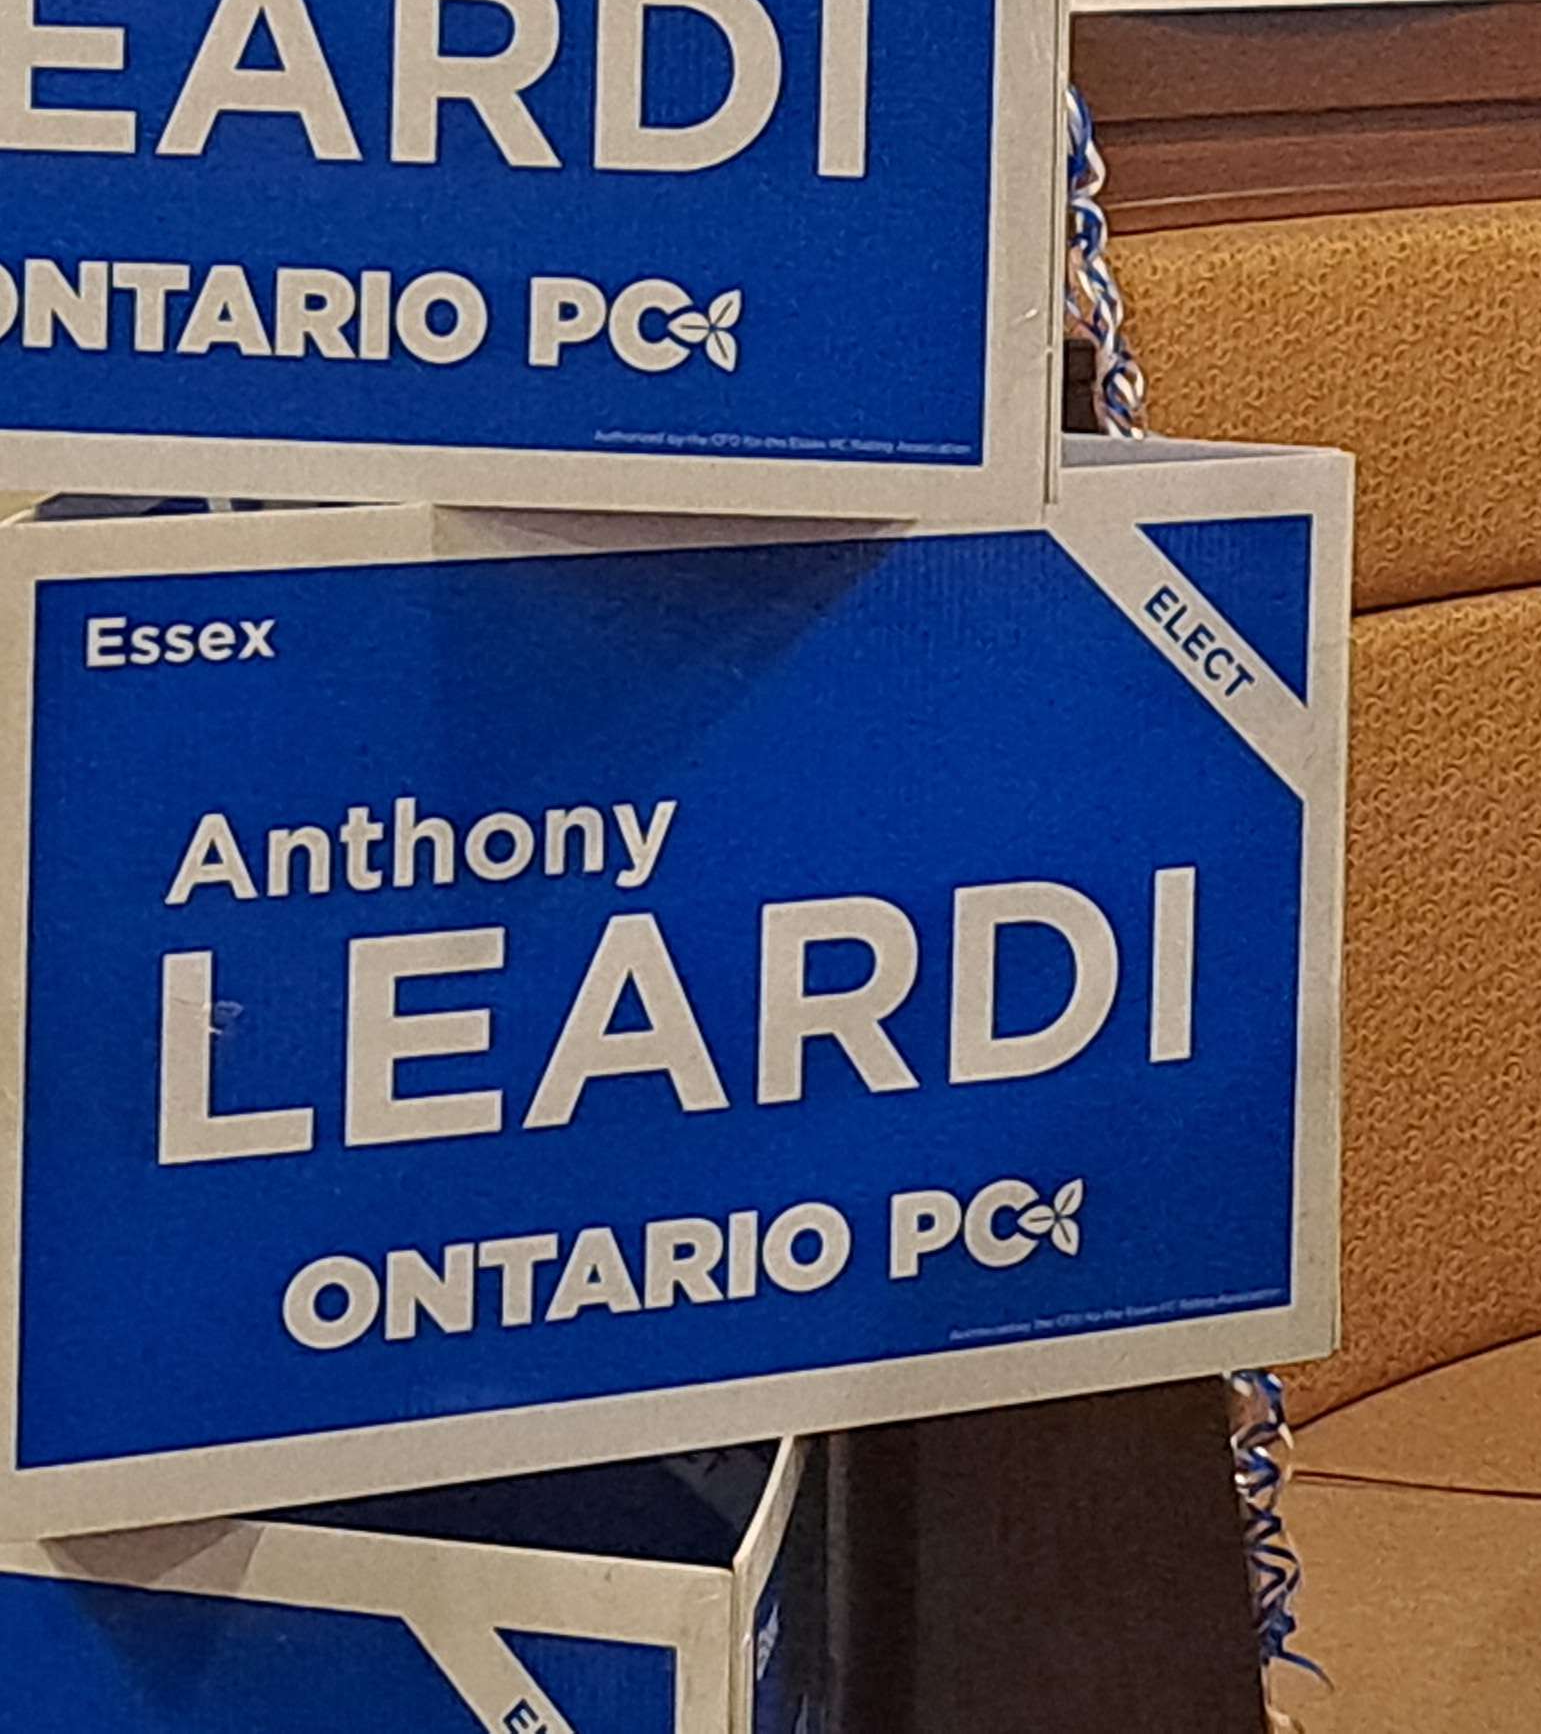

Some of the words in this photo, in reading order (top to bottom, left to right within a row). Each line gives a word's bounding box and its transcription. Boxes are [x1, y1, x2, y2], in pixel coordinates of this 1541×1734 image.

[0, 258, 488, 365] NTARIO
[529, 276, 694, 373] PC
[86, 613, 276, 668] Essex
[1143, 584, 1255, 701] ELECT
[165, 796, 677, 906] Anthony
[157, 865, 1197, 1168] LEARDI
[282, 1200, 852, 1351] ONTARIO
[890, 1179, 1038, 1280] PC
